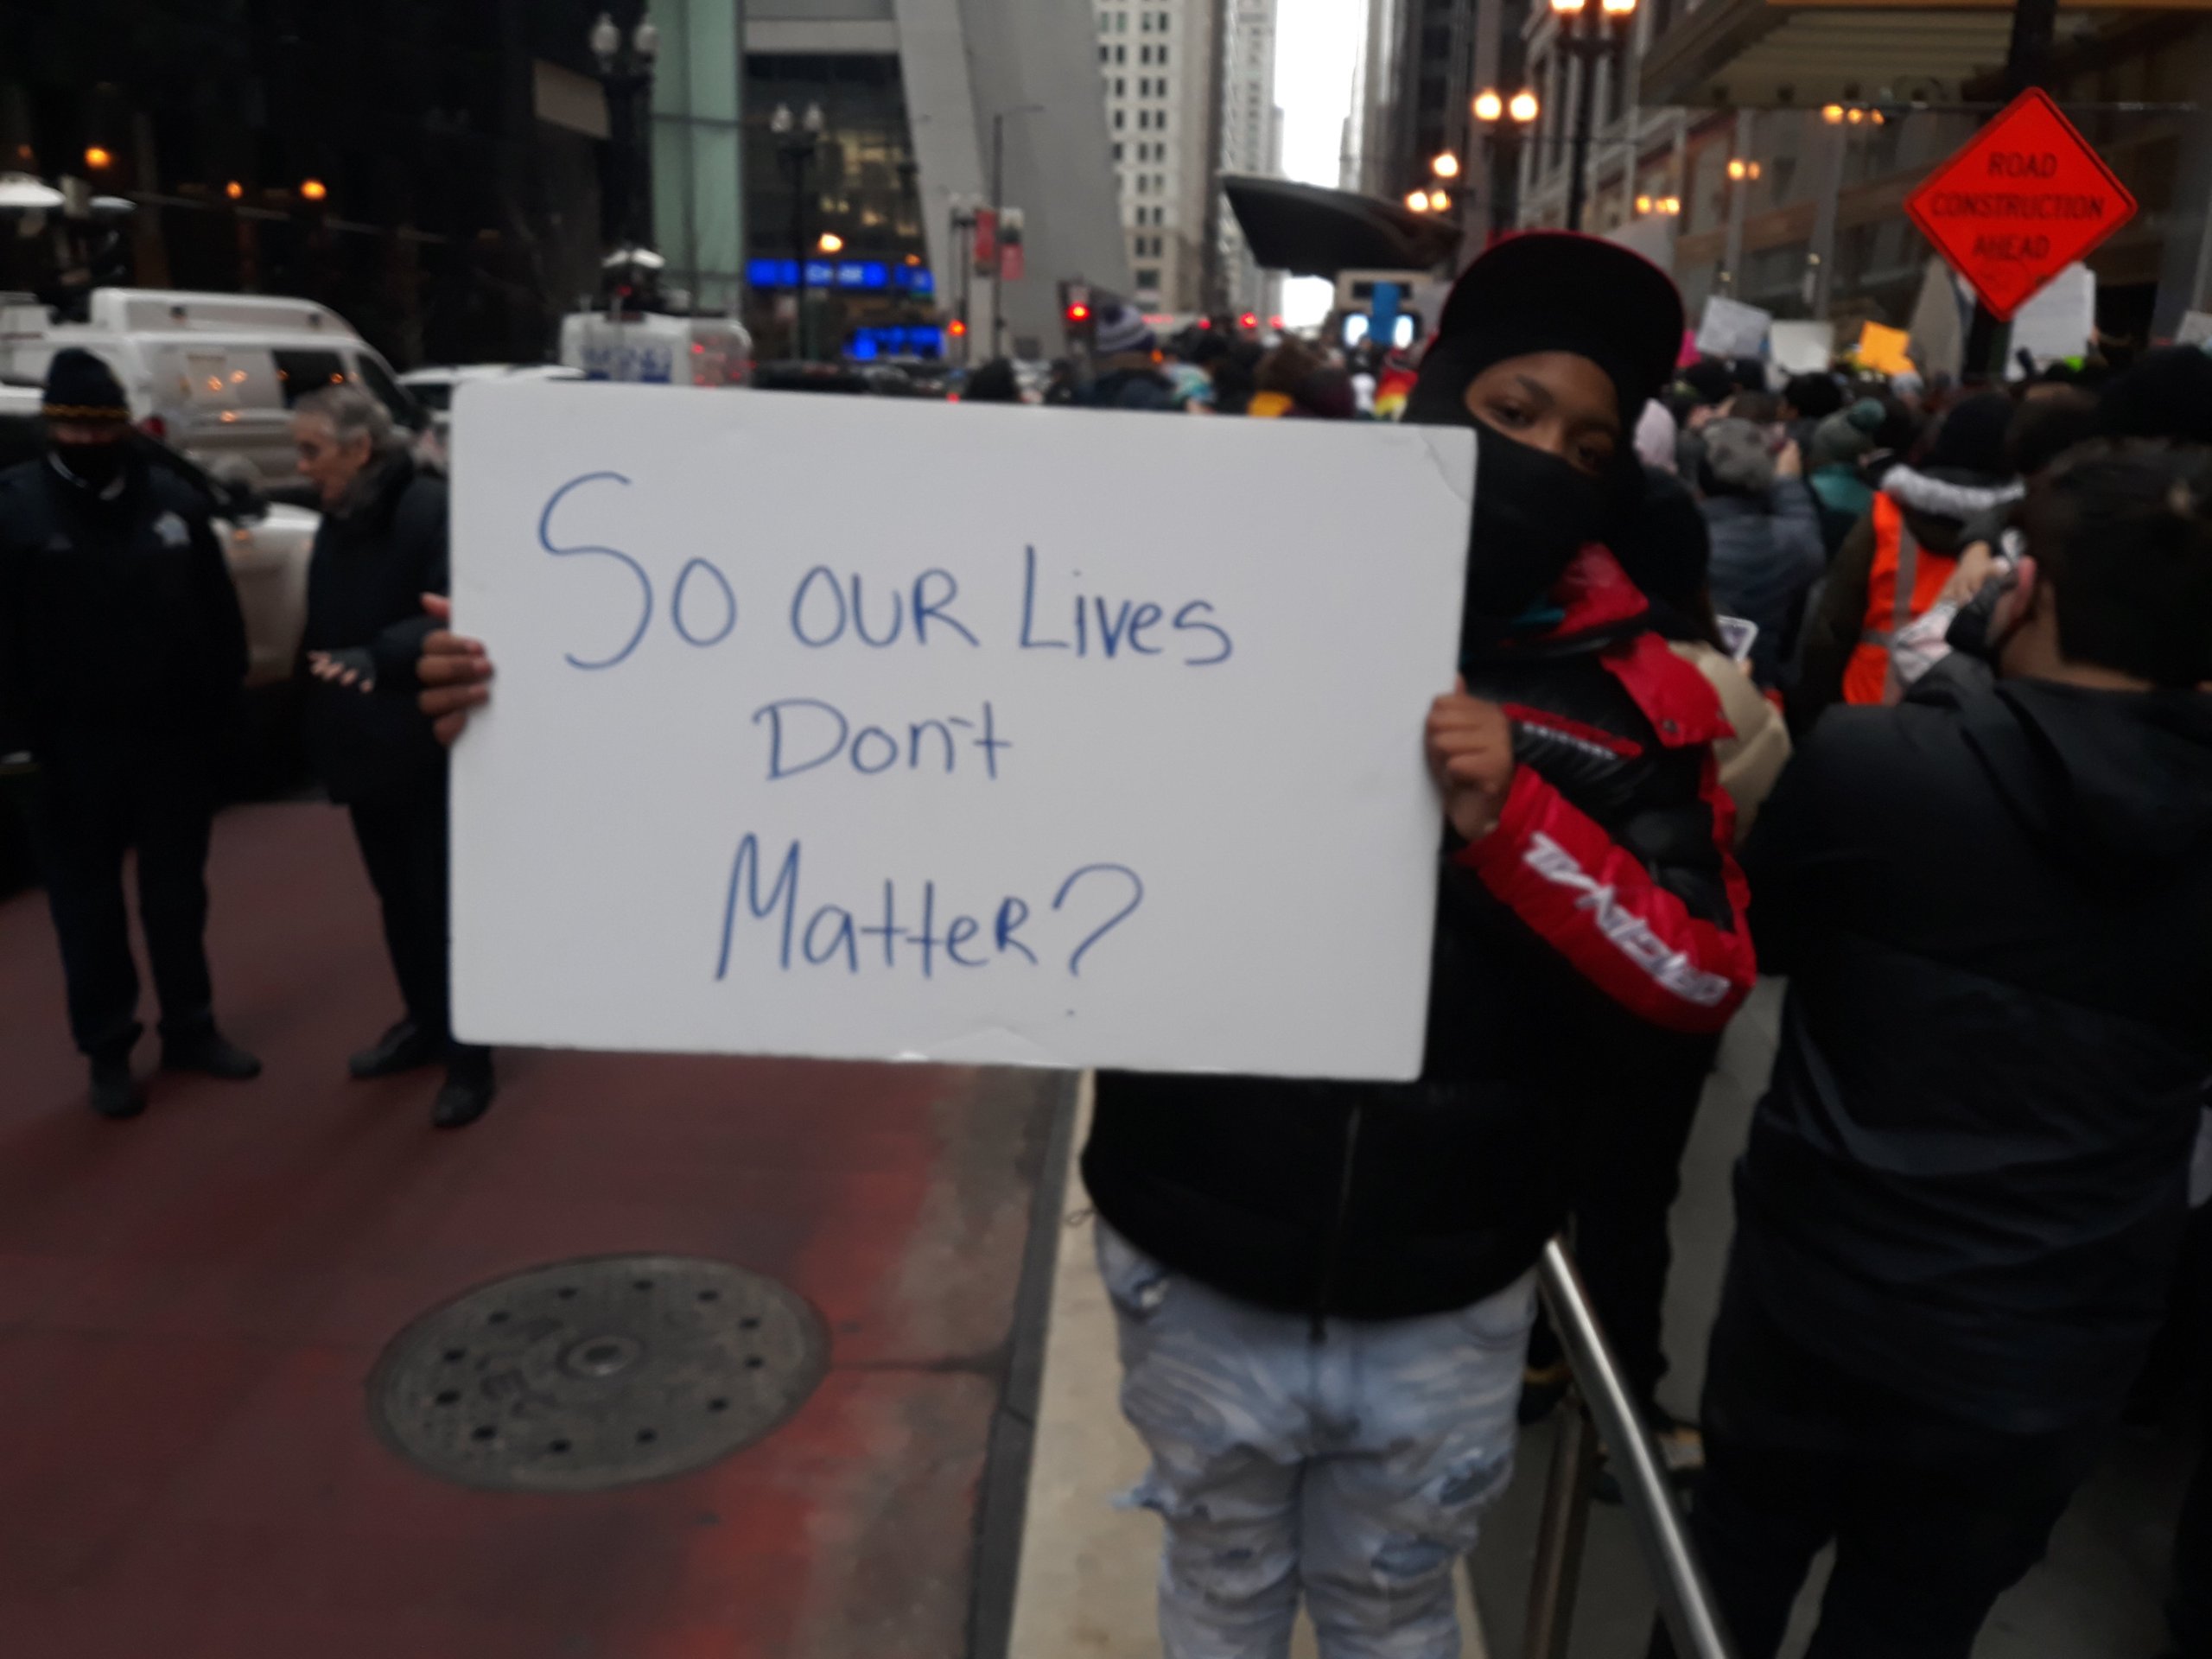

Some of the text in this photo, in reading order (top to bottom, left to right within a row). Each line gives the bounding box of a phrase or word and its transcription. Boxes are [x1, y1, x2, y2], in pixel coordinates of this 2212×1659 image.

[1989, 153, 2057, 177] ROAD
[1931, 192, 2105, 219] CONSTRUCTION
[1972, 234, 2051, 261] AHEAD
[1019, 543, 1233, 666] Lives
